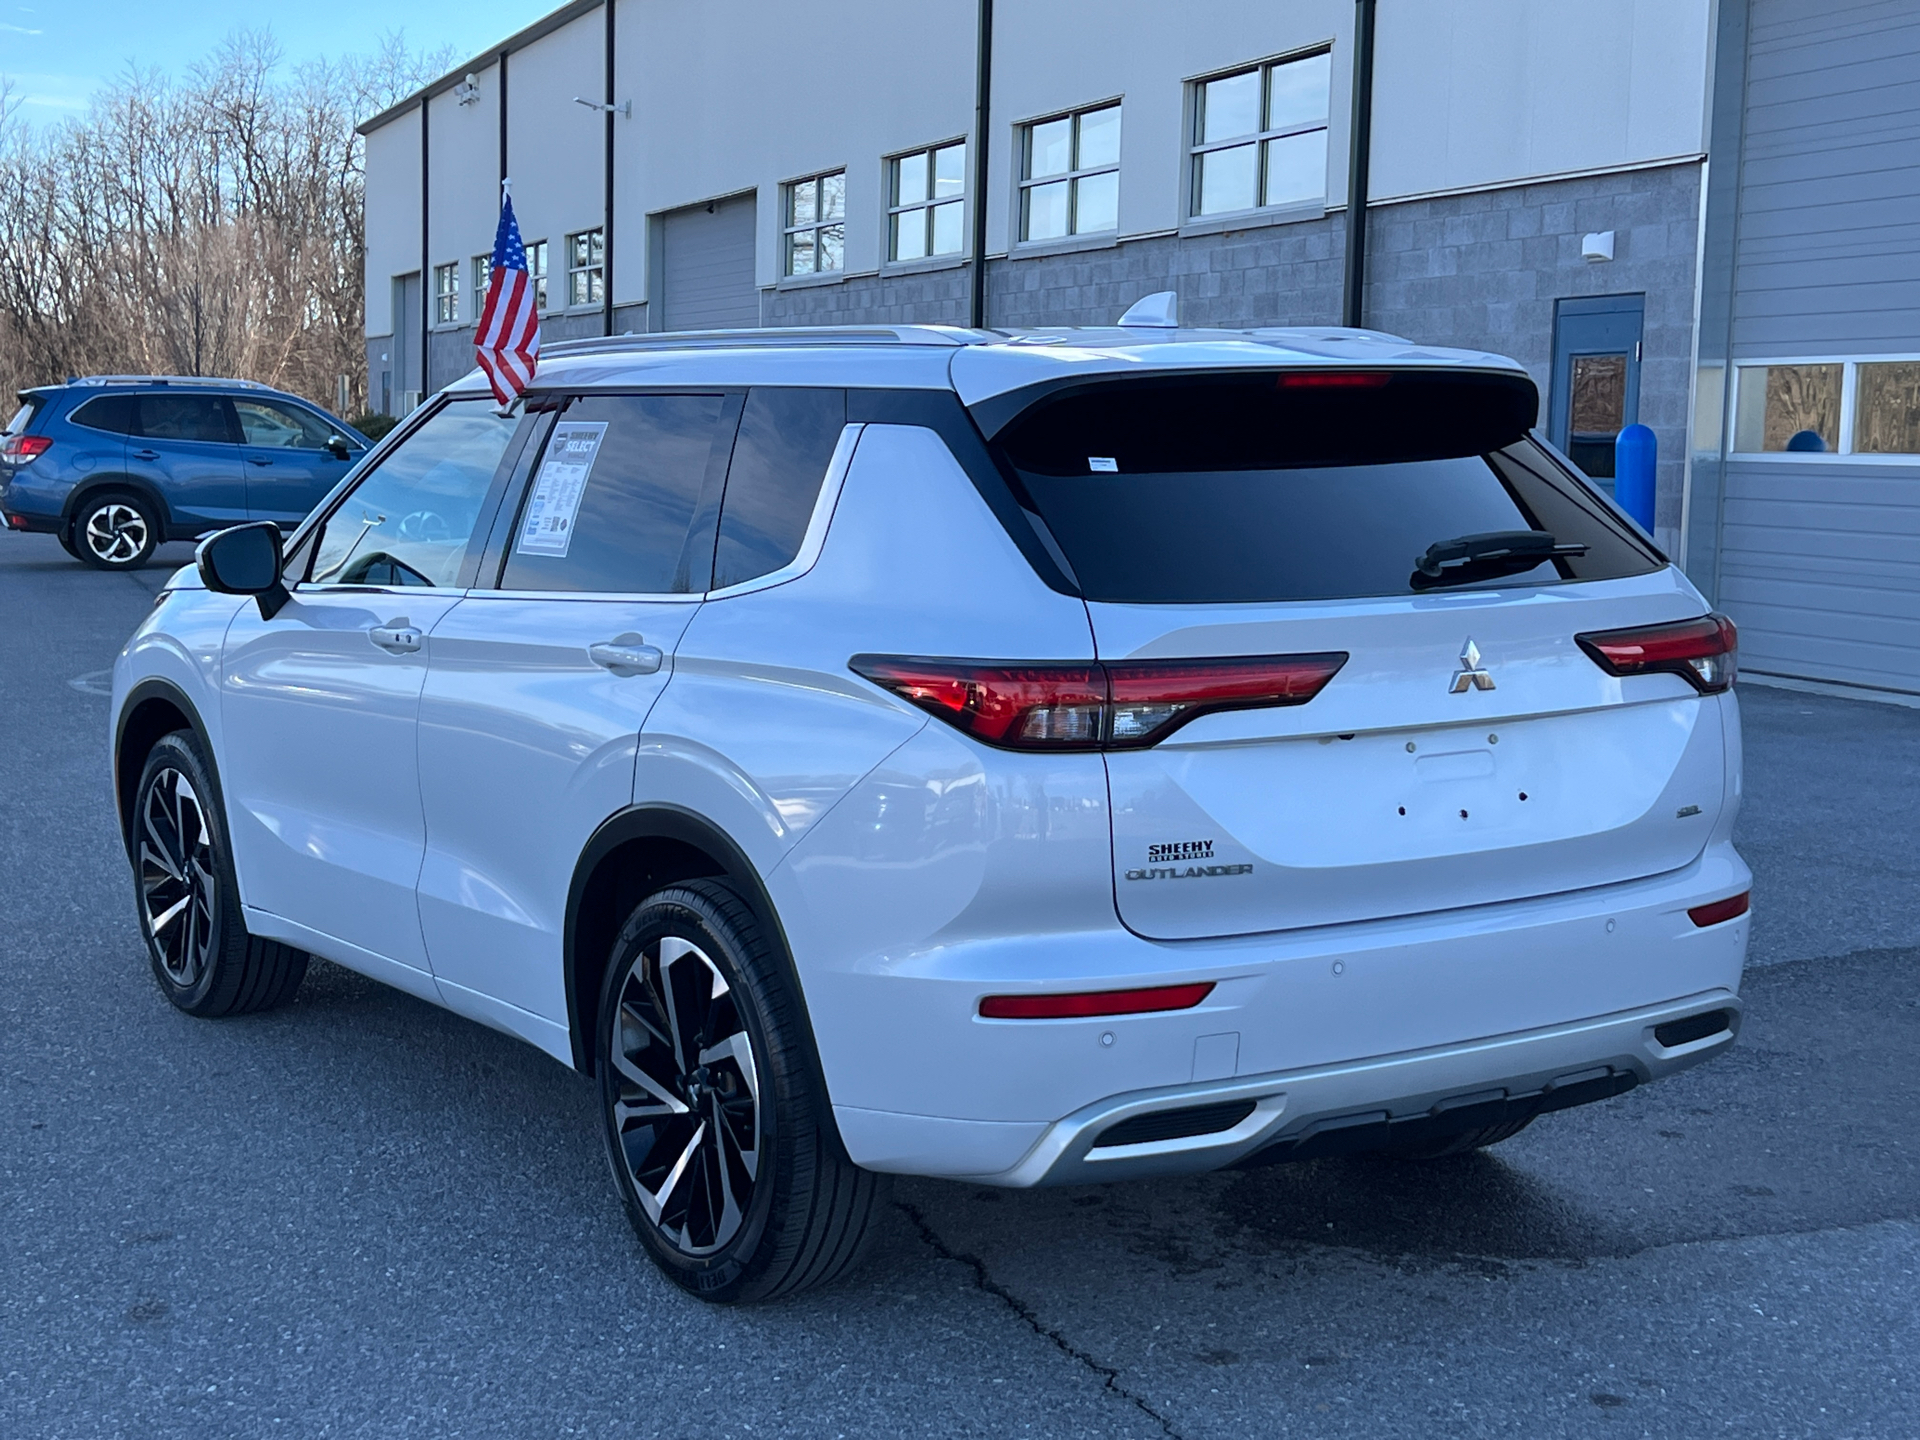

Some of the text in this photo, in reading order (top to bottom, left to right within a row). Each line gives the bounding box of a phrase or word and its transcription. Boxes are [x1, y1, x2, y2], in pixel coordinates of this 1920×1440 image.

[565, 440, 596, 452] SELECT
[1148, 840, 1213, 855] SHEEHY
[1125, 864, 1253, 880] OUTLANDER
